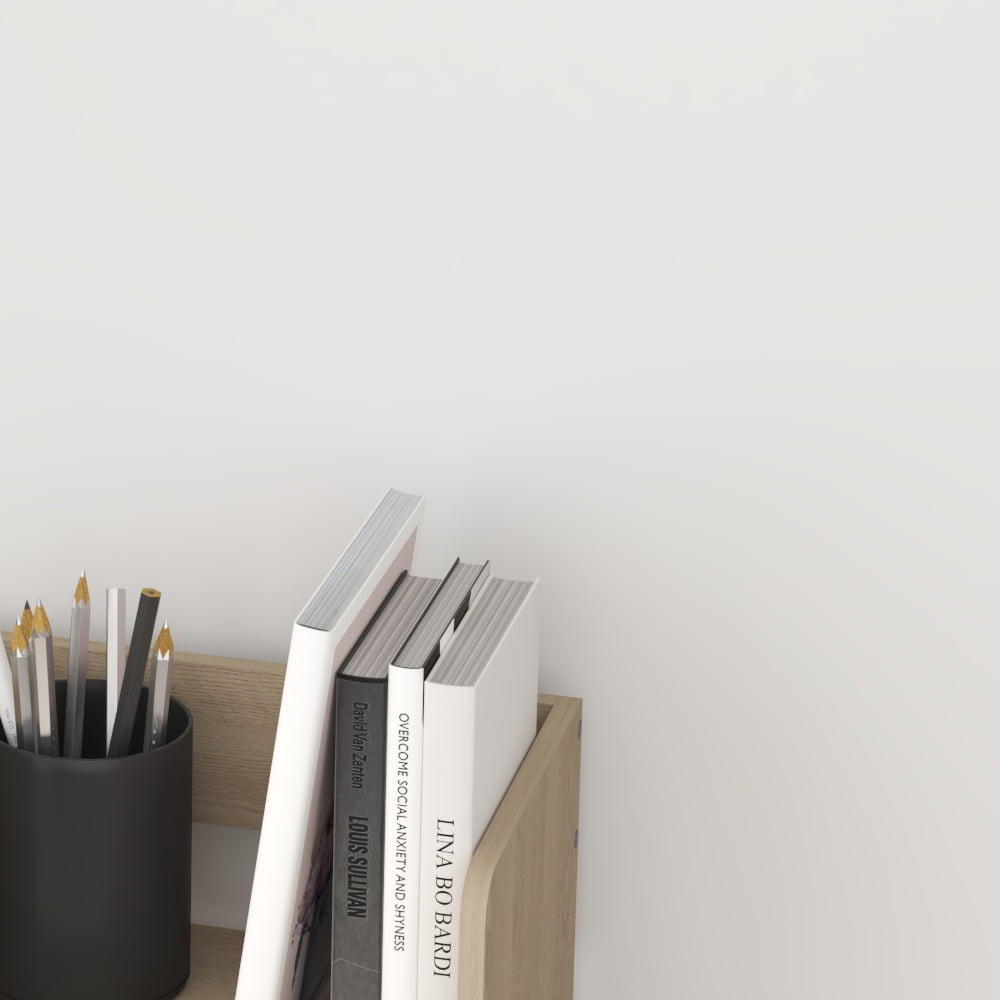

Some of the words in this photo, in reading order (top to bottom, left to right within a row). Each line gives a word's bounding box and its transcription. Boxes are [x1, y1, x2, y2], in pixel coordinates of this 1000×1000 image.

[353, 702, 368, 731] David
[353, 733, 367, 751] Van
[398, 712, 410, 777] OVERCOME
[352, 753, 366, 789] Zanten
[397, 779, 408, 821] SOCIAL
[347, 816, 369, 854] LOUIS
[396, 822, 408, 873] ANXIETY
[436, 818, 455, 868] LINA
[346, 856, 368, 919] SULLIVAN
[395, 874, 406, 901] AND
[435, 876, 454, 905] BO
[394, 903, 406, 952] SHYNESS
[433, 912, 453, 978] BARDI
